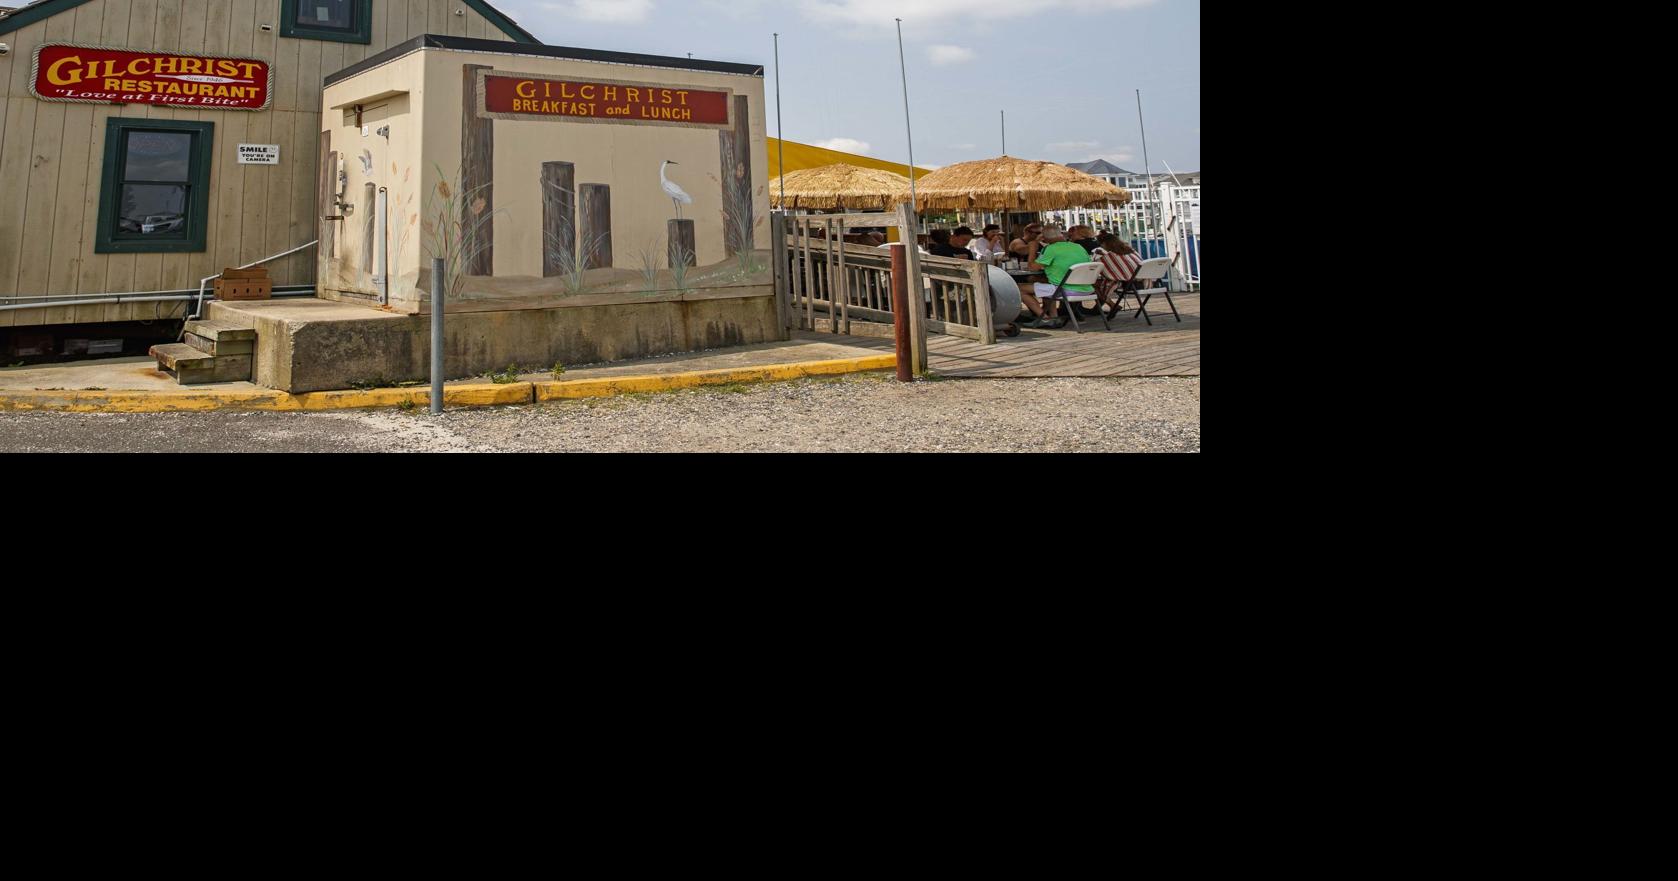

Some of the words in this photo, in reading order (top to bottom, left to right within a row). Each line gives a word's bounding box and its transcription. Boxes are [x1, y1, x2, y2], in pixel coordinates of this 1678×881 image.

[46, 55, 262, 85] GILCHRIST
[55, 89, 116, 98] "Love
[149, 94, 196, 103] First
[200, 97, 249, 106] Bite"
[104, 78, 260, 98] RESTAURANT
[517, 81, 689, 104] GILCHRIST
[513, 99, 596, 116] BREAKFAST
[606, 104, 631, 116] and
[641, 108, 691, 120] LUNCH
